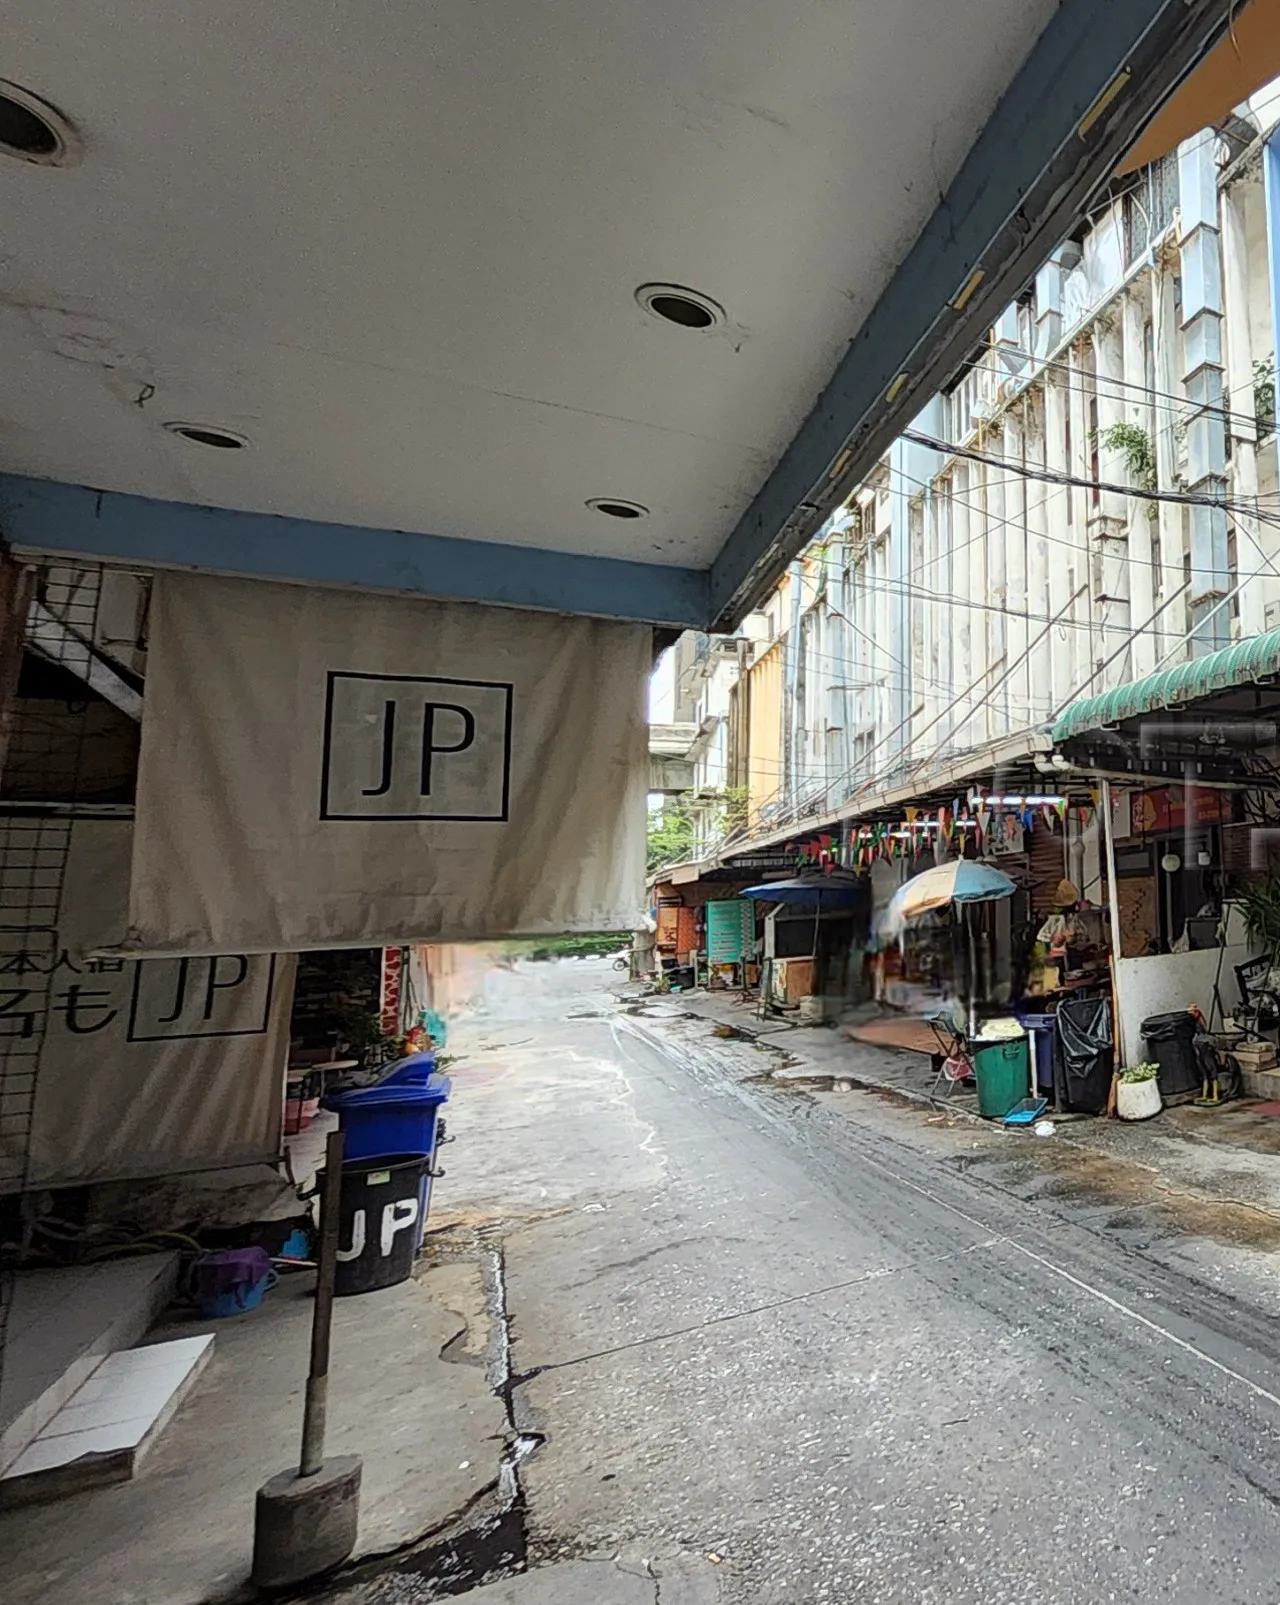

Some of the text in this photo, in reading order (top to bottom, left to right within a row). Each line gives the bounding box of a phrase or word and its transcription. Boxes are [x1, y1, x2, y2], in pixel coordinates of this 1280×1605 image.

[361, 700, 476, 796] JP
[158, 955, 248, 1023] JP
[336, 1198, 418, 1262] JP
